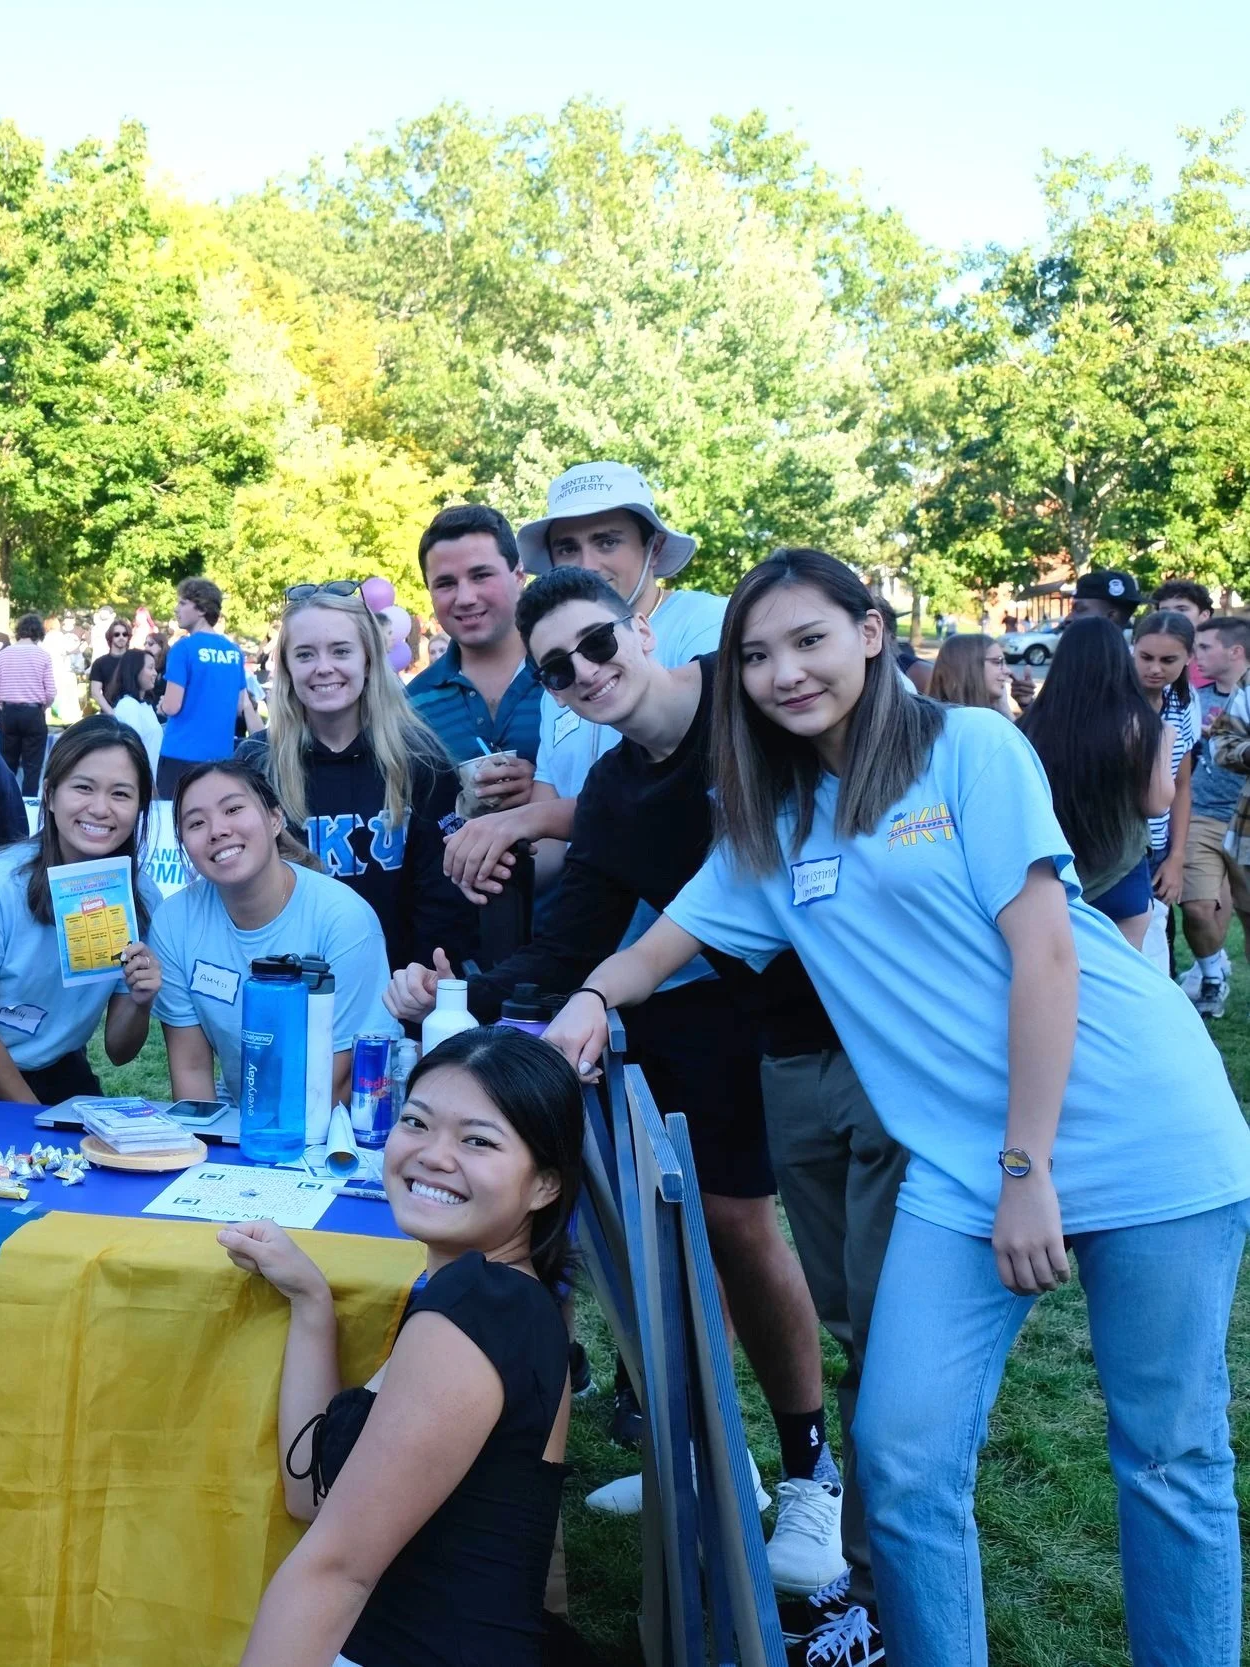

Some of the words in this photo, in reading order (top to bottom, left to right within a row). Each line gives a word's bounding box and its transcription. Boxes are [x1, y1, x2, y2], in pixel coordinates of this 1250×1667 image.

[561, 475, 604, 491] BENTLEY
[198, 648, 240, 664] STAFF
[246, 1063, 258, 1116] everyday
